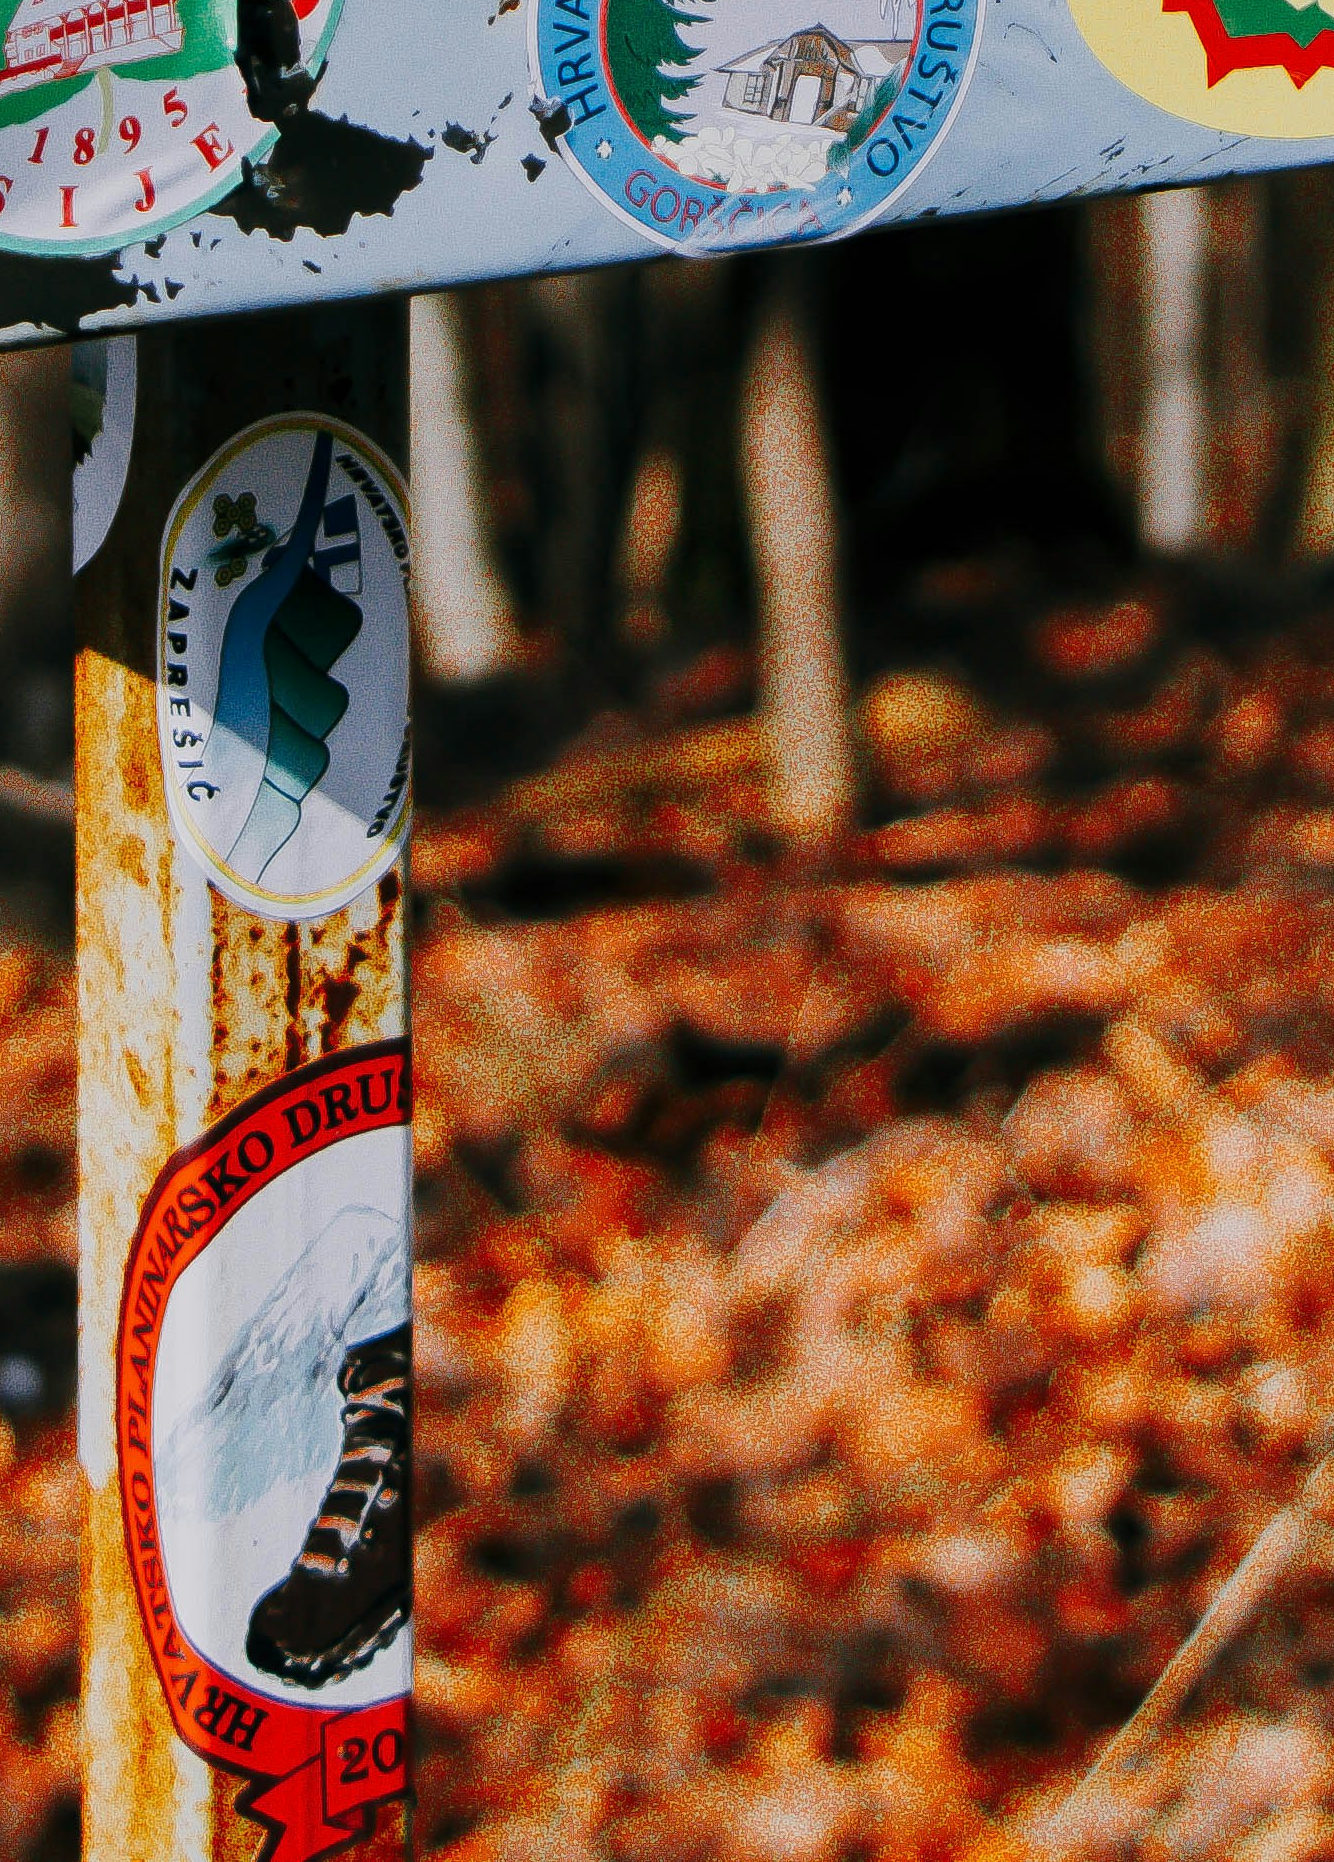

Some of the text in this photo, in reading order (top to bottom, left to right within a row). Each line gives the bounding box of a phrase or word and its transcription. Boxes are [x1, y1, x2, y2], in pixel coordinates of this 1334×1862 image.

[27, 87, 188, 166] 1895
[128, 1068, 410, 1752] HRVATSKO PLANINARSKO DRU
